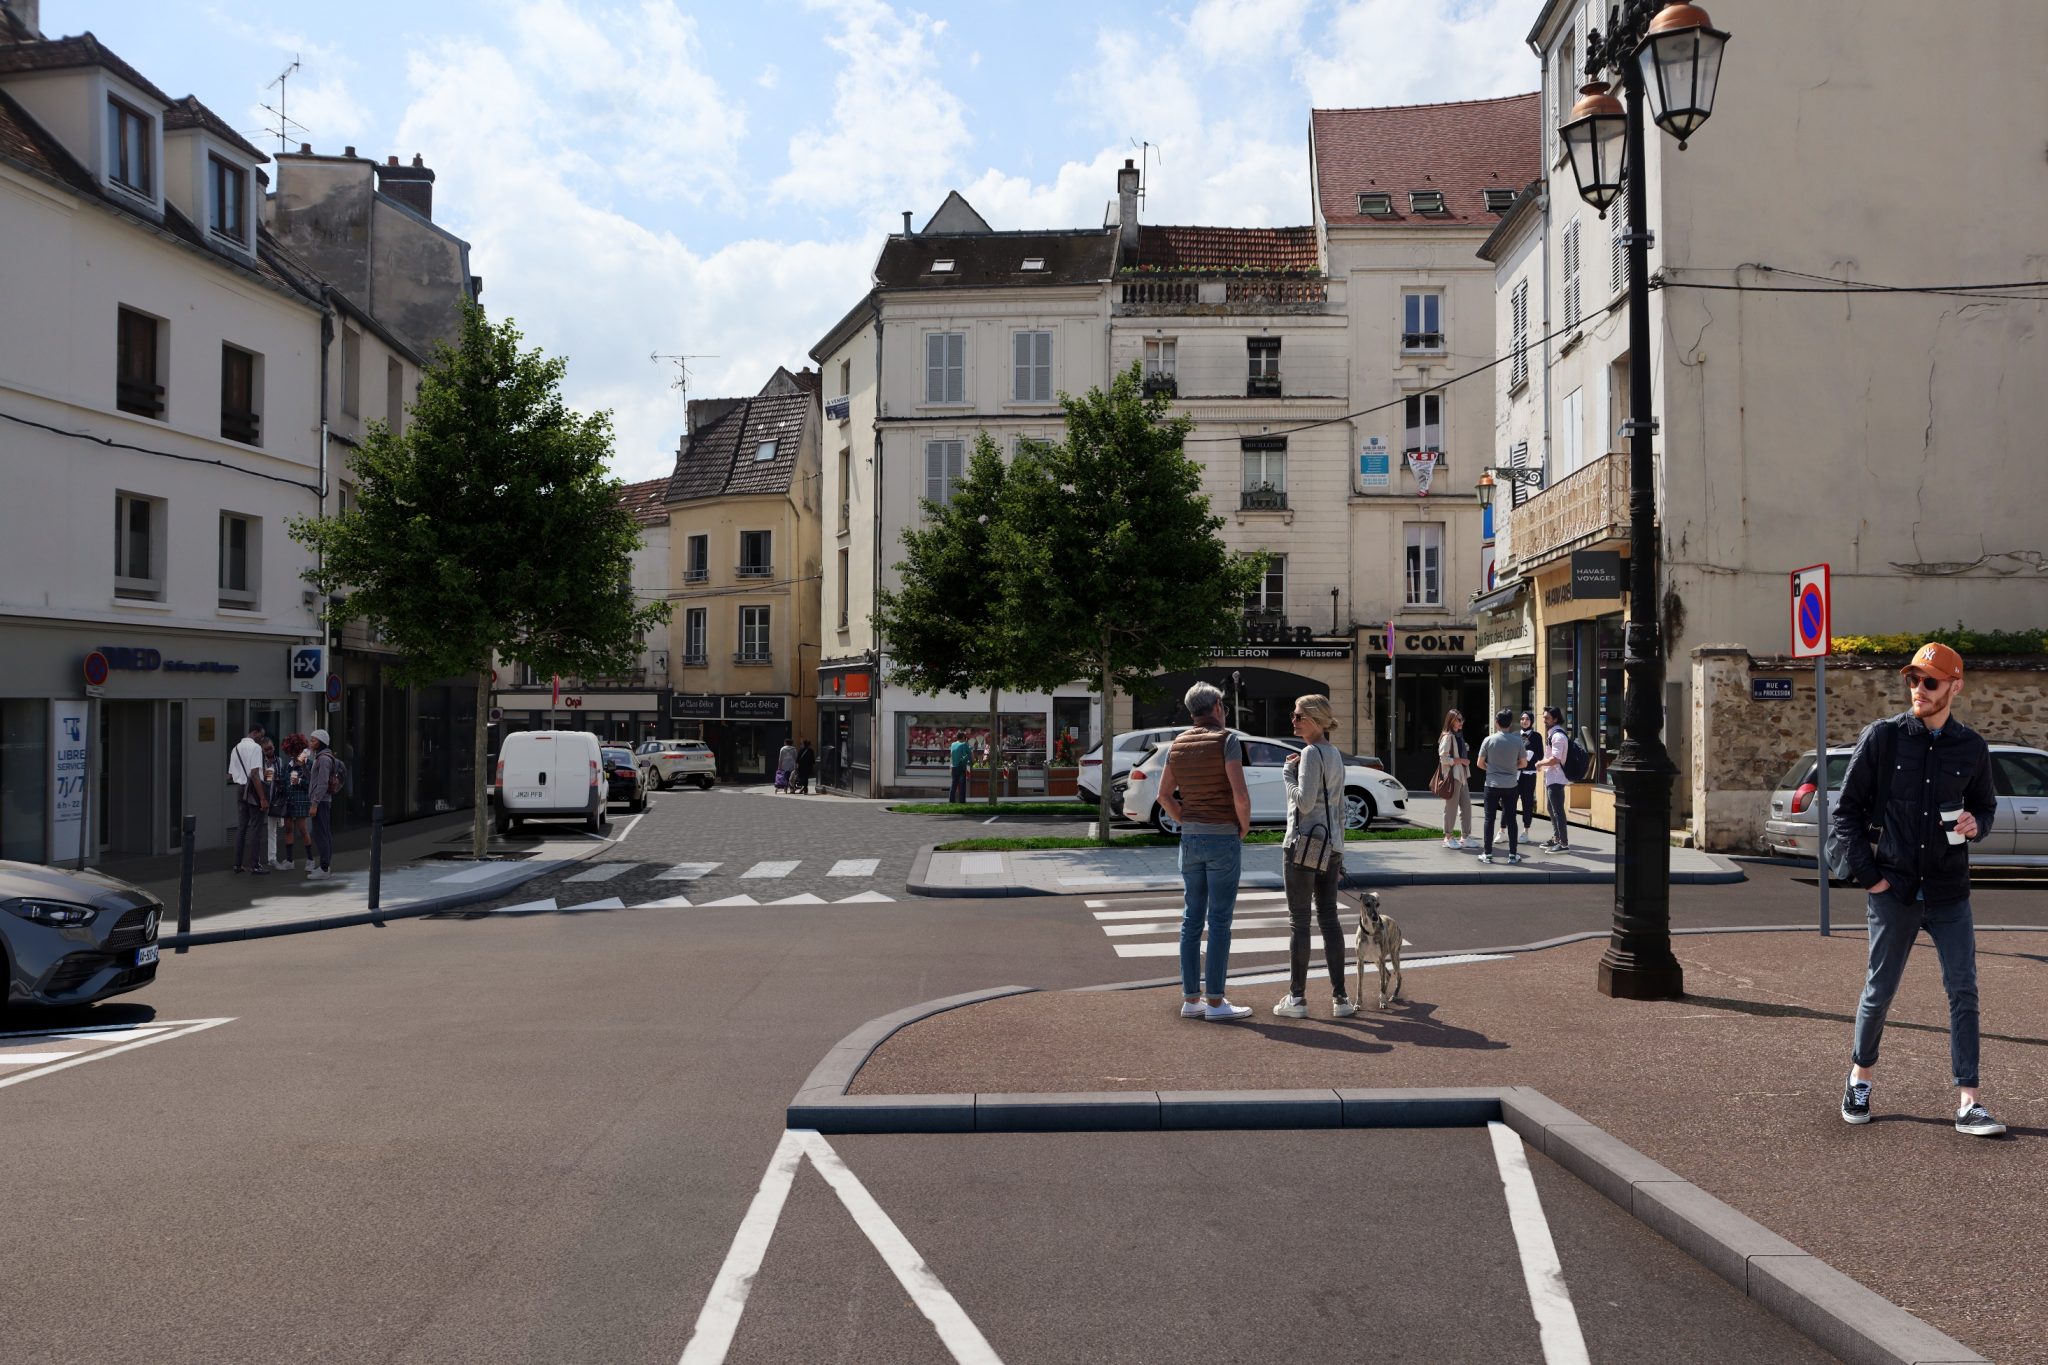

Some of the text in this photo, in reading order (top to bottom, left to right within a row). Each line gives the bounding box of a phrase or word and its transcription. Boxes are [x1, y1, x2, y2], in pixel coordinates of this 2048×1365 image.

[1300, 649, 1342, 657] Pâtisserie
[1444, 664, 1457, 673] AU
[1461, 664, 1484, 673] COIN
[565, 696, 582, 708] Orpi
[730, 700, 738, 709] Le
[740, 700, 757, 709] Clos
[57, 749, 86, 761] LIBRE
[57, 762, 86, 771] SERVICE
[57, 775, 86, 798] 7j/7
